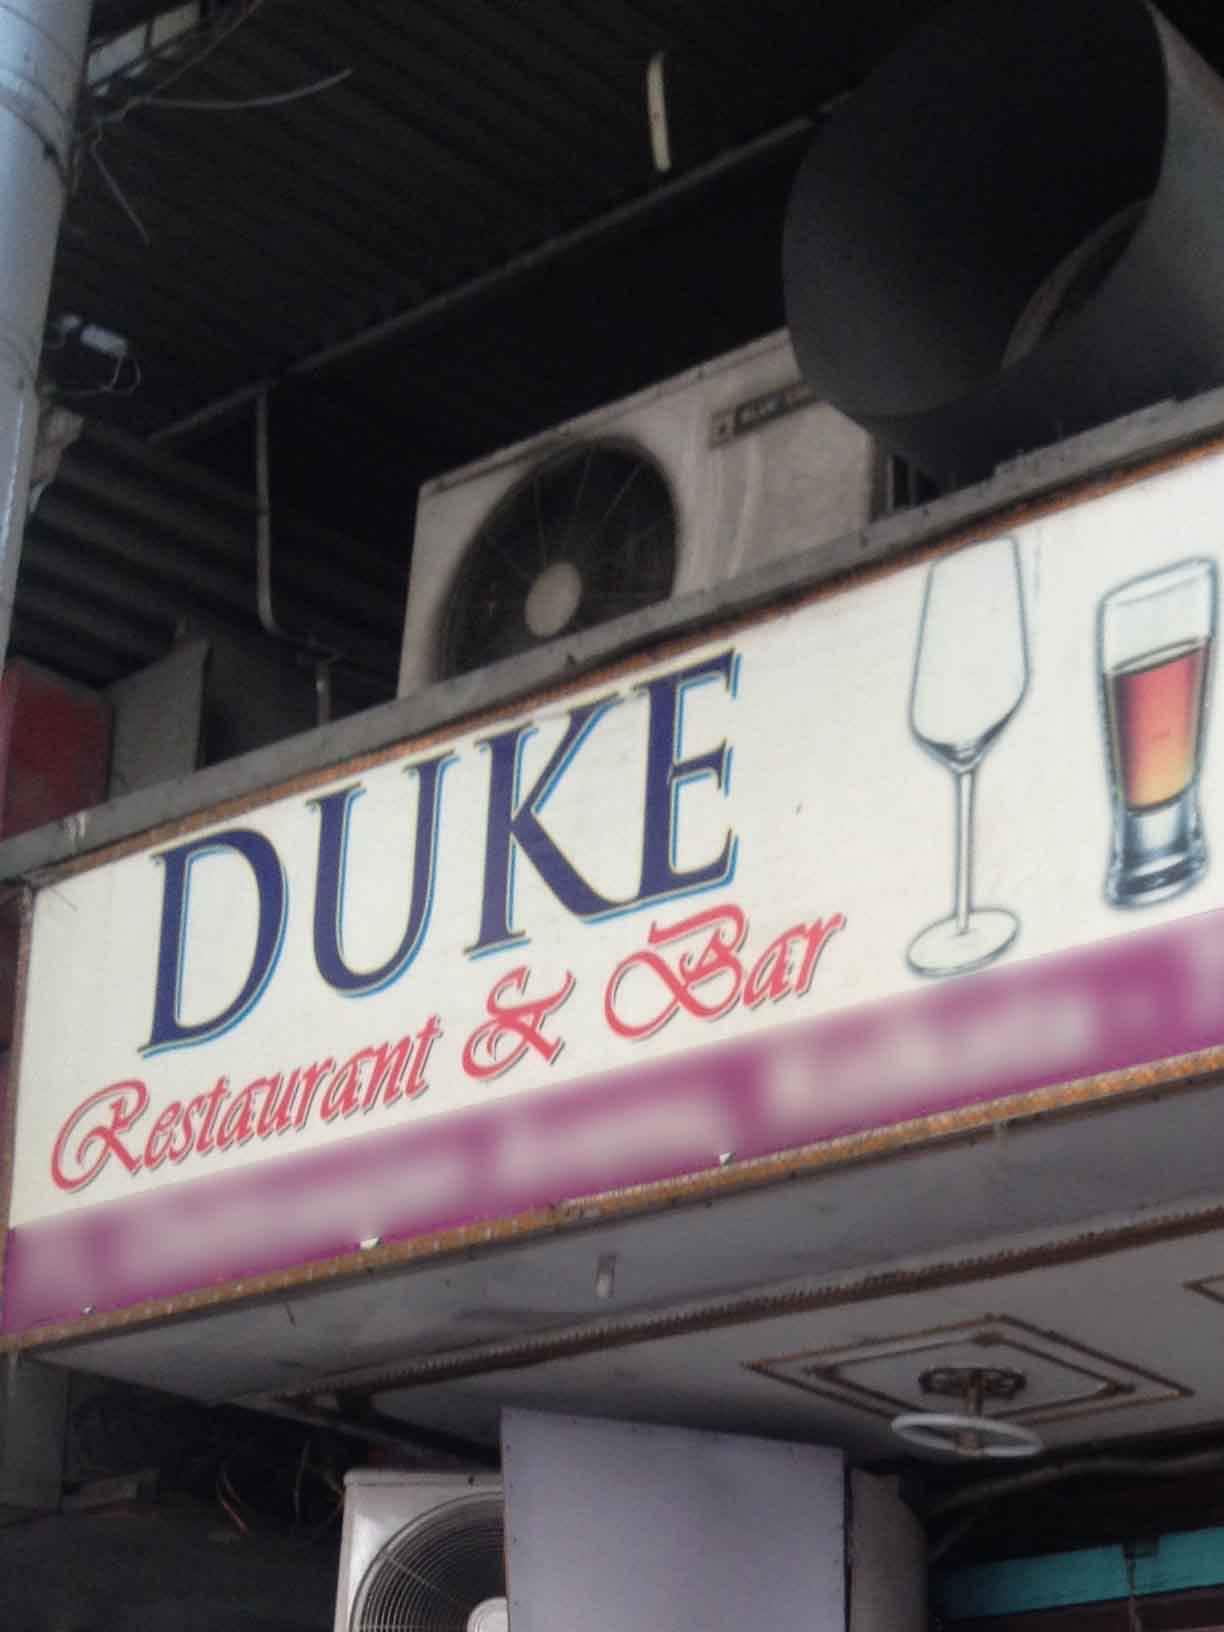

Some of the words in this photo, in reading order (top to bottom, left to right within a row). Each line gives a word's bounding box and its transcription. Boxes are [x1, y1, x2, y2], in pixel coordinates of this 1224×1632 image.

[143, 651, 742, 1057] DUKE
[52, 1015, 441, 1193] Restaurant
[463, 966, 571, 1080] &
[605, 905, 844, 1039] Bar
